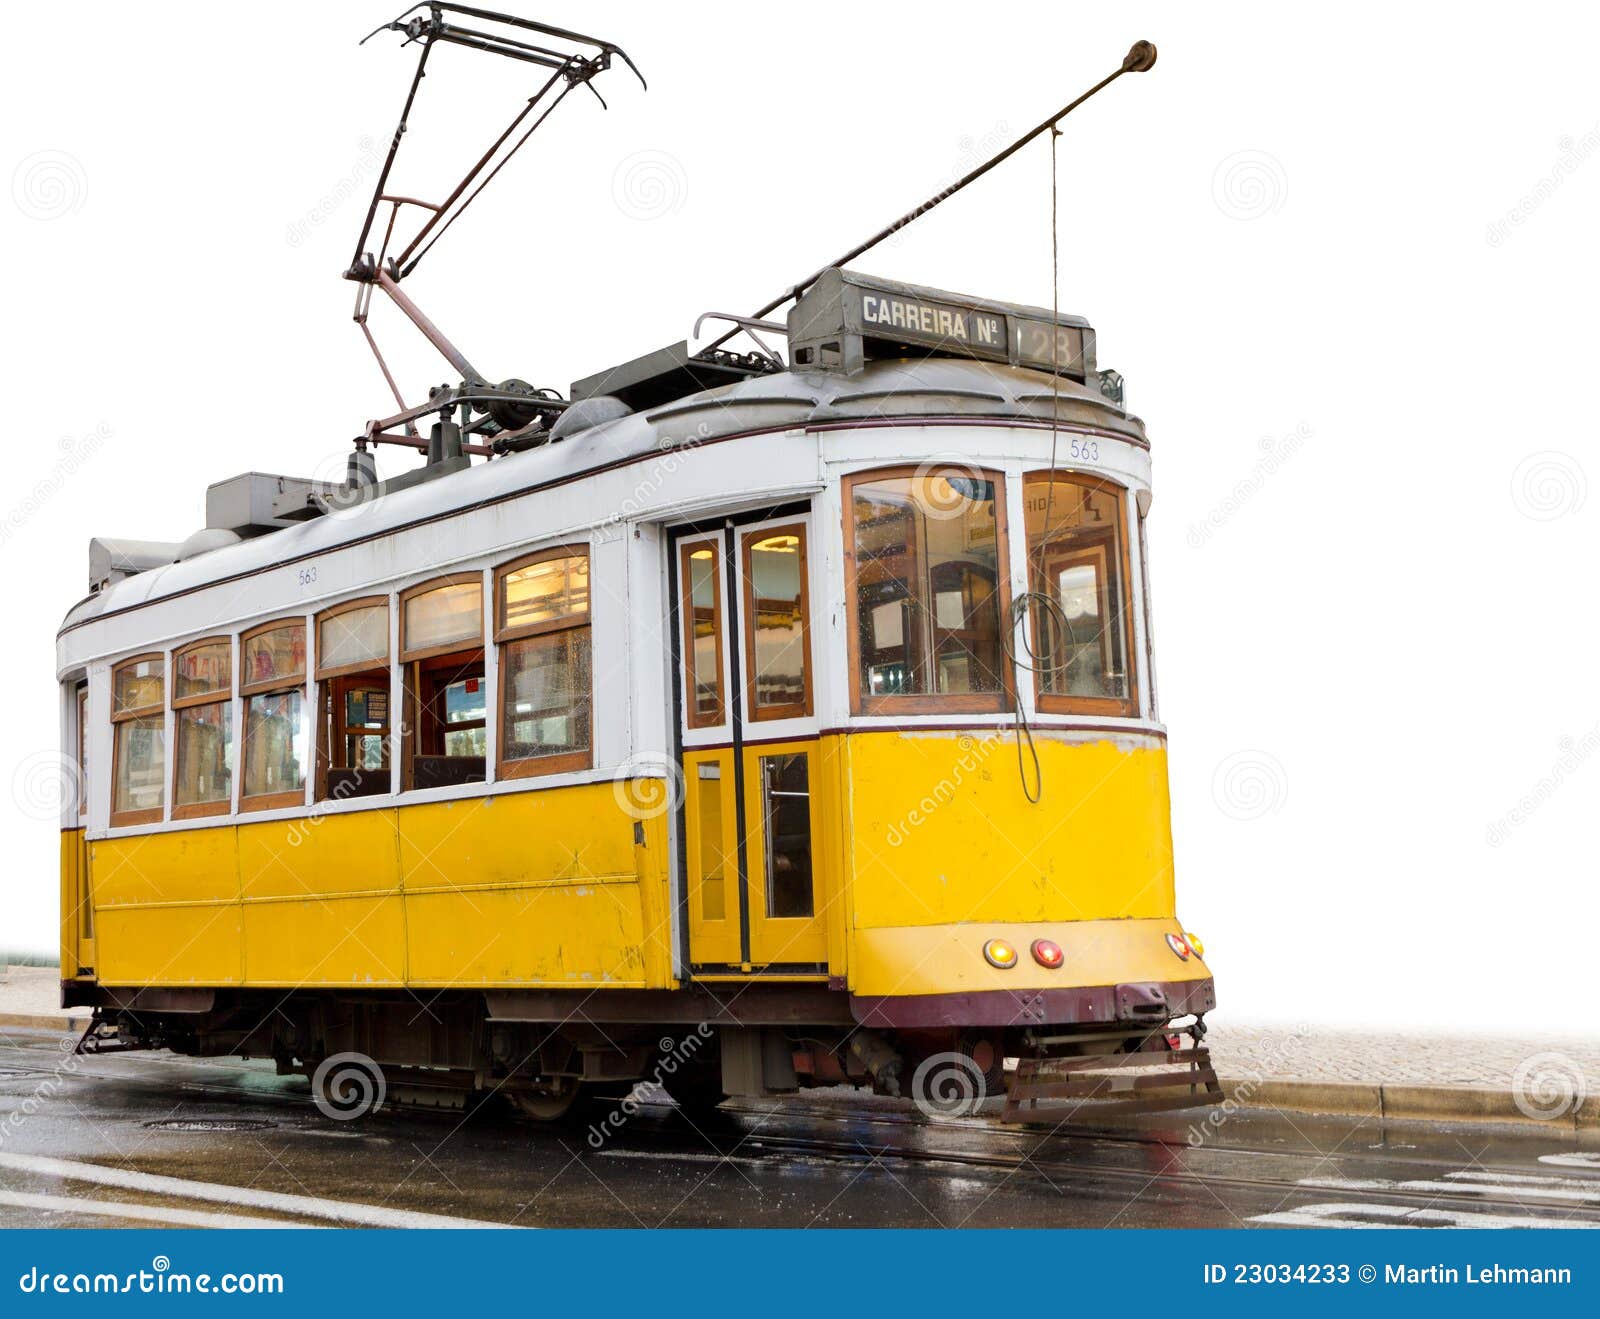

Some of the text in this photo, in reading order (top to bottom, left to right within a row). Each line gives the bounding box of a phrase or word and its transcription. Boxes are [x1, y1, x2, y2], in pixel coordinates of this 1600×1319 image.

[862, 295, 967, 339] CARREIRA
[1031, 329, 1072, 365] 28
[1070, 439, 1099, 462] 563
[299, 566, 317, 586] 563
